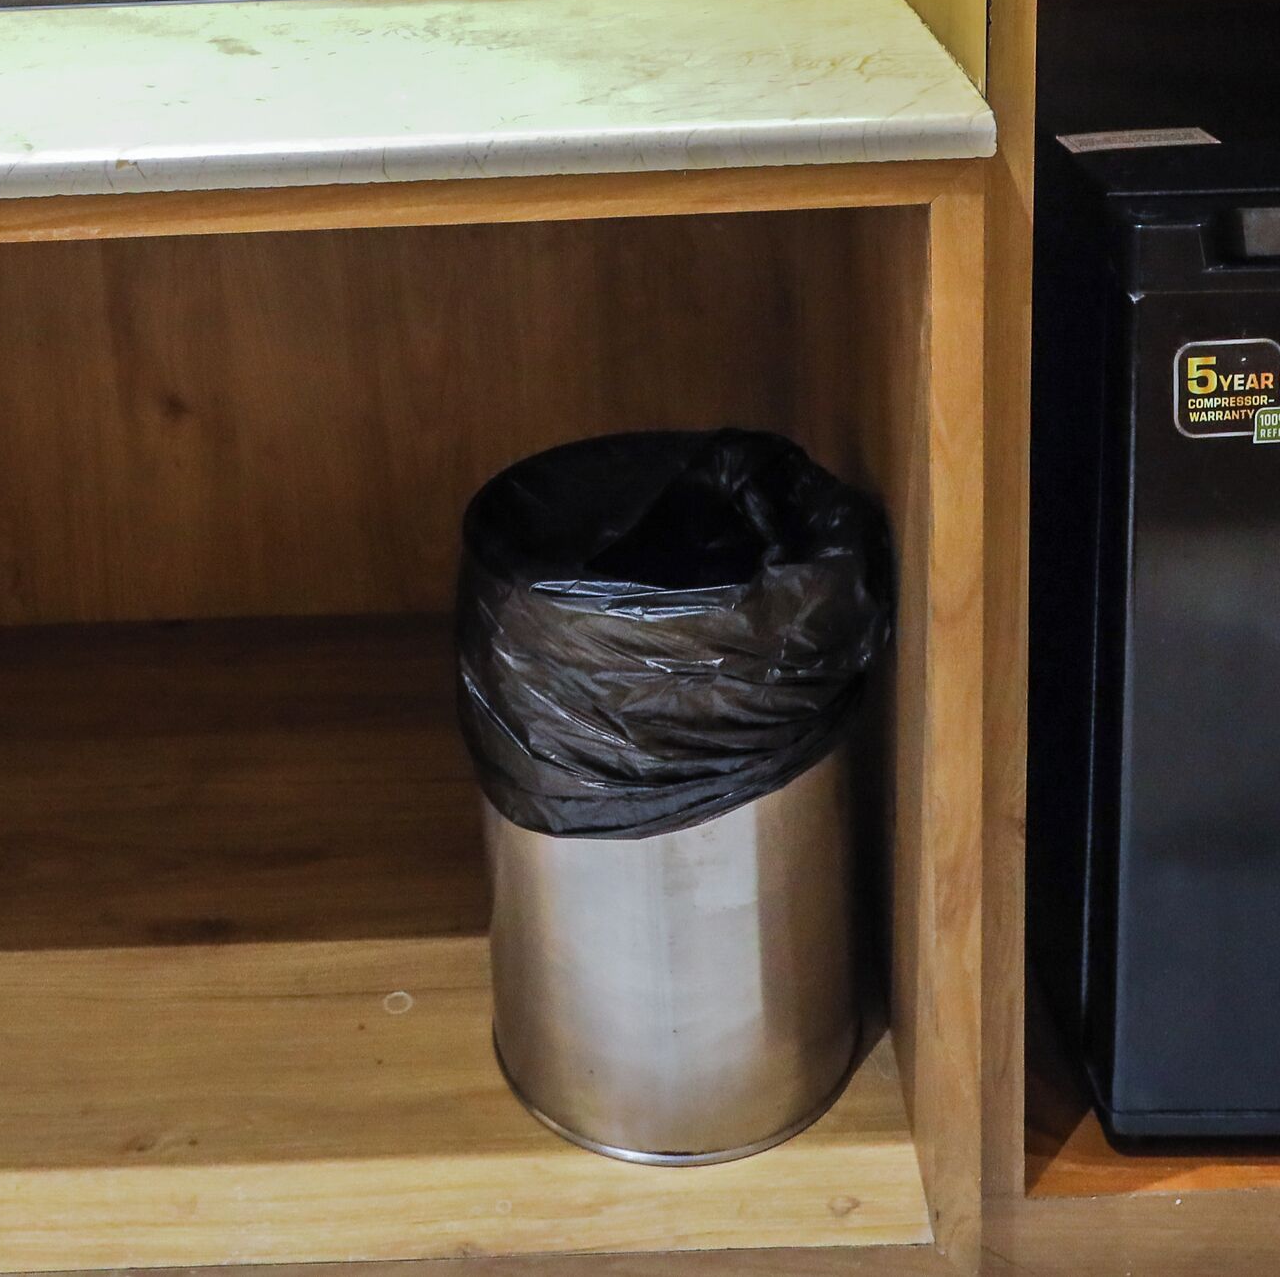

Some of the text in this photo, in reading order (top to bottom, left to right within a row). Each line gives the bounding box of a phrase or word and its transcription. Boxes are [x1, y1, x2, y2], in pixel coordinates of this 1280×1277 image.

[1187, 356, 1274, 394] 5 YEAR
[1188, 395, 1275, 410] COMPRESSOR-
[1189, 409, 1255, 423] WARRANTY
